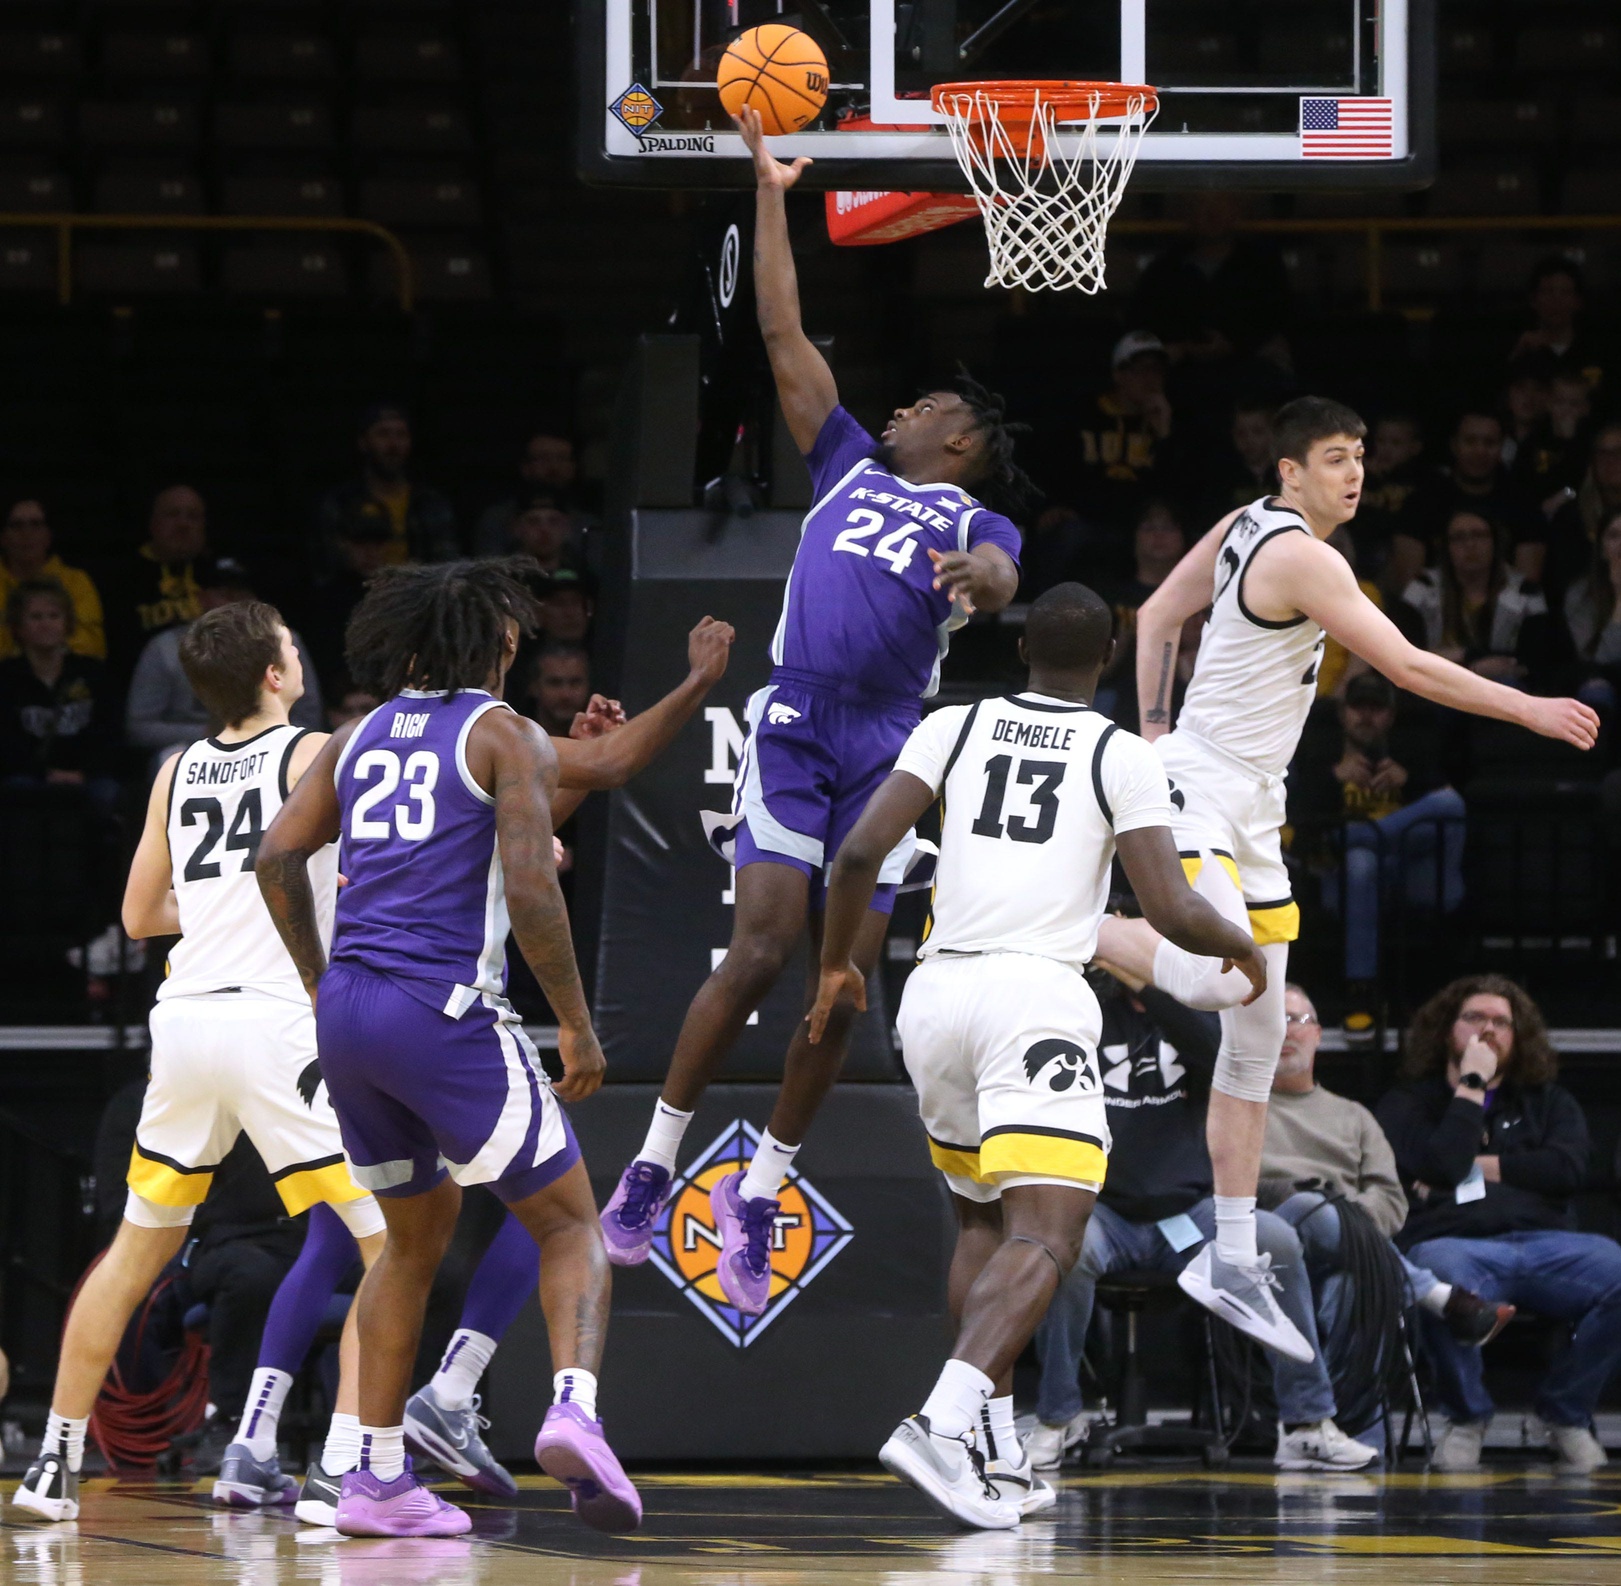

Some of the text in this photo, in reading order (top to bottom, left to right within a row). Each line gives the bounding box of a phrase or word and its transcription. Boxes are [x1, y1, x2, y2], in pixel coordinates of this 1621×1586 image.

[623, 104, 653, 115] NIT
[638, 136, 717, 153] SPALDING
[848, 487, 954, 532] K-STATE
[833, 507, 924, 575] 24
[390, 712, 431, 739] RICH
[992, 719, 1077, 751] DEMBELE
[186, 751, 269, 785] SANDFORT
[350, 749, 441, 842] 23
[971, 753, 1068, 845] 13
[180, 787, 269, 883] 24
[1104, 1096, 1141, 1108] NDER
[684, 1215, 801, 1251] NT
